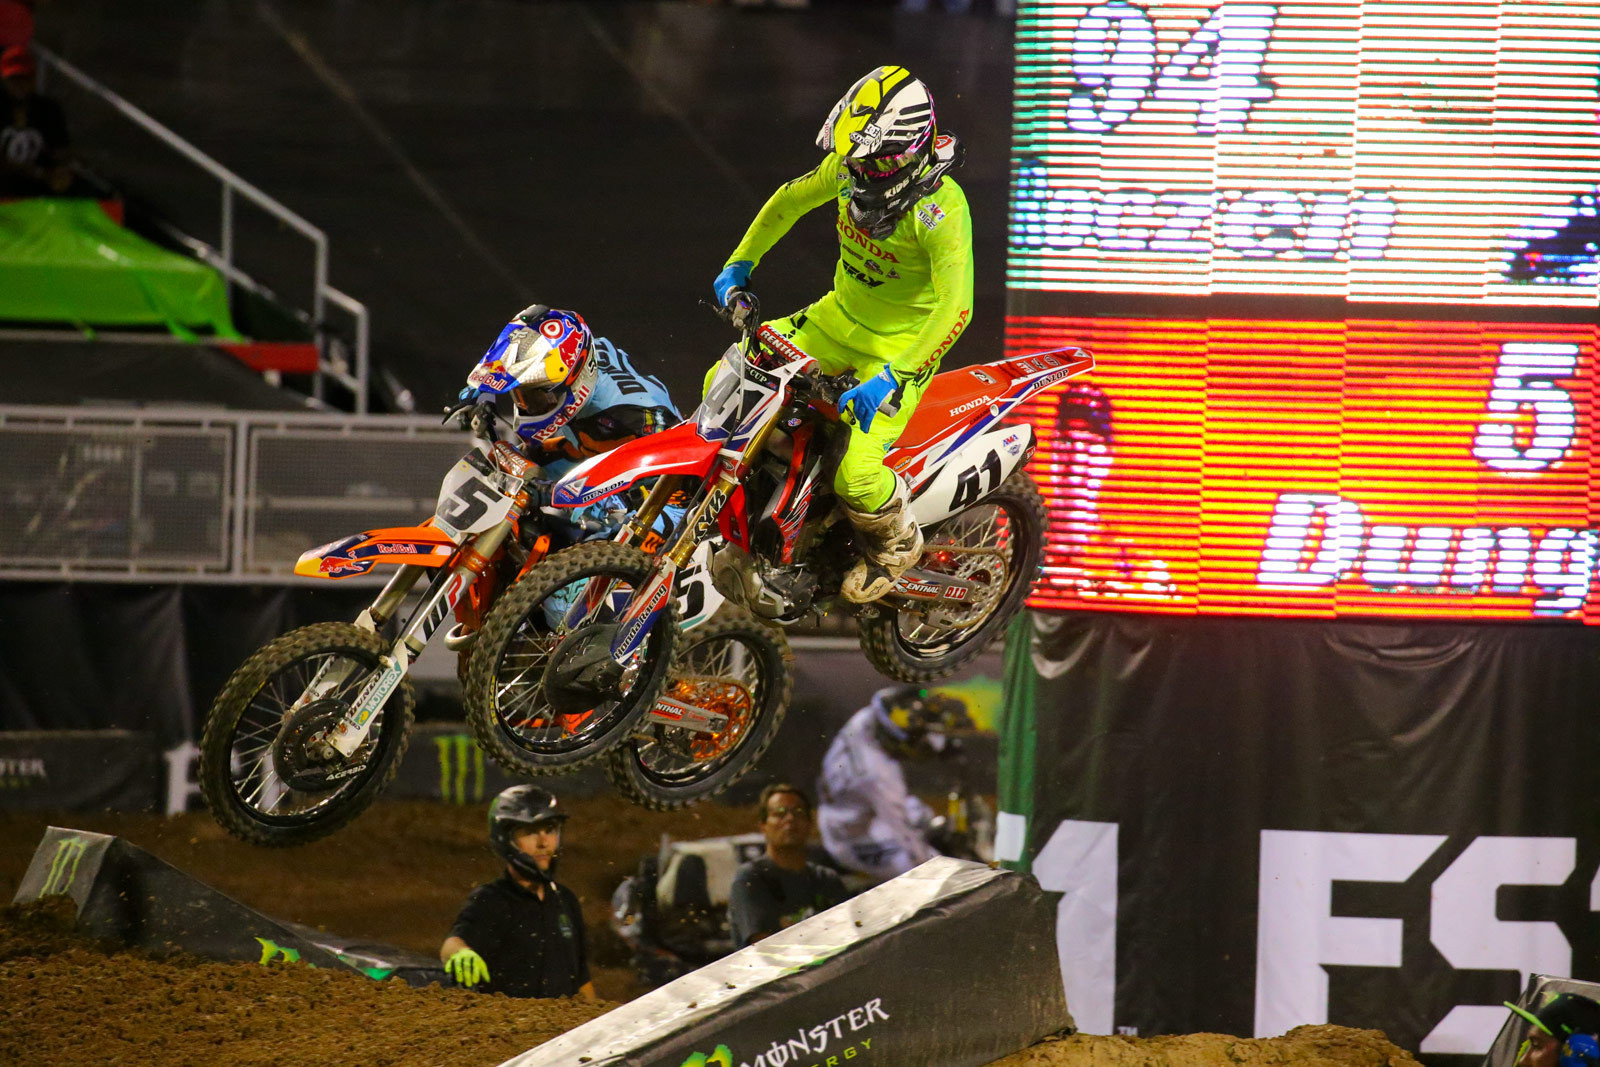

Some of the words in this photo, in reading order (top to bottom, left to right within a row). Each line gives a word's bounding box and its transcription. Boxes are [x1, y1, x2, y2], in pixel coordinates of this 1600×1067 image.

[1066, 2, 1278, 134] 94
[837, 215, 901, 264] HONDA
[760, 330, 802, 361] RENTHA
[917, 308, 969, 373] HONDA
[484, 374, 507, 391] Bull
[750, 369, 768, 383] CUP
[1033, 369, 1069, 390] DUNLOP
[532, 413, 568, 441] Red
[564, 385, 590, 418] Bull
[949, 395, 992, 417] HONDA
[1472, 342, 1580, 477] 5
[435, 475, 503, 531] 5
[949, 448, 1001, 512] 41
[377, 543, 399, 553] Red
[399, 543, 418, 554] Bull
[613, 622, 642, 659] Honda
[639, 583, 668, 627] Racing
[366, 669, 401, 712] MOTOREX
[655, 702, 683, 716] NTHAL
[1253, 829, 1600, 1055] FS
[810, 1038, 872, 1067] RGY
